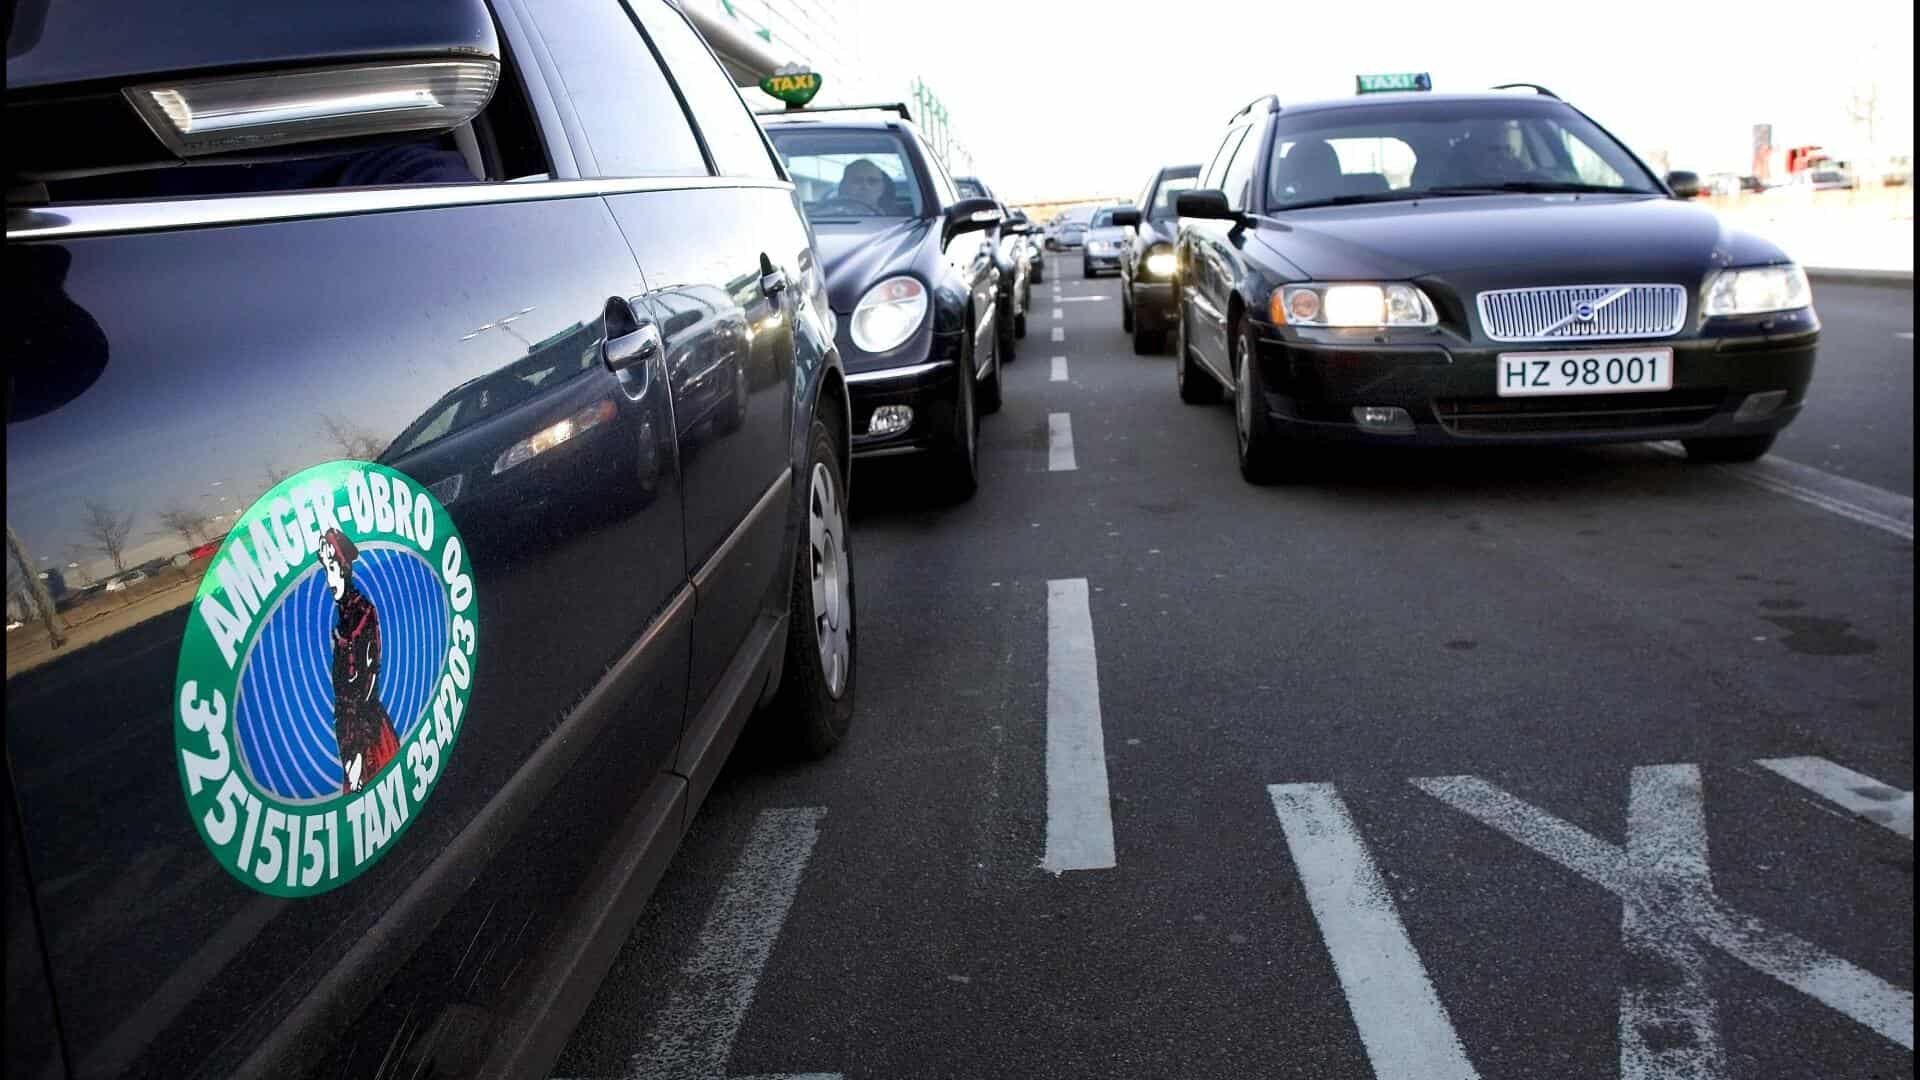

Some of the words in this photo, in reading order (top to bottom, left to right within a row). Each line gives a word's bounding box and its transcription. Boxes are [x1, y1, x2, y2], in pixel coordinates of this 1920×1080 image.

[769, 74, 815, 92] TAXI
[1361, 75, 1409, 89] TAXI
[1506, 361, 1551, 388] HZ
[346, 775, 410, 867] TAXI
